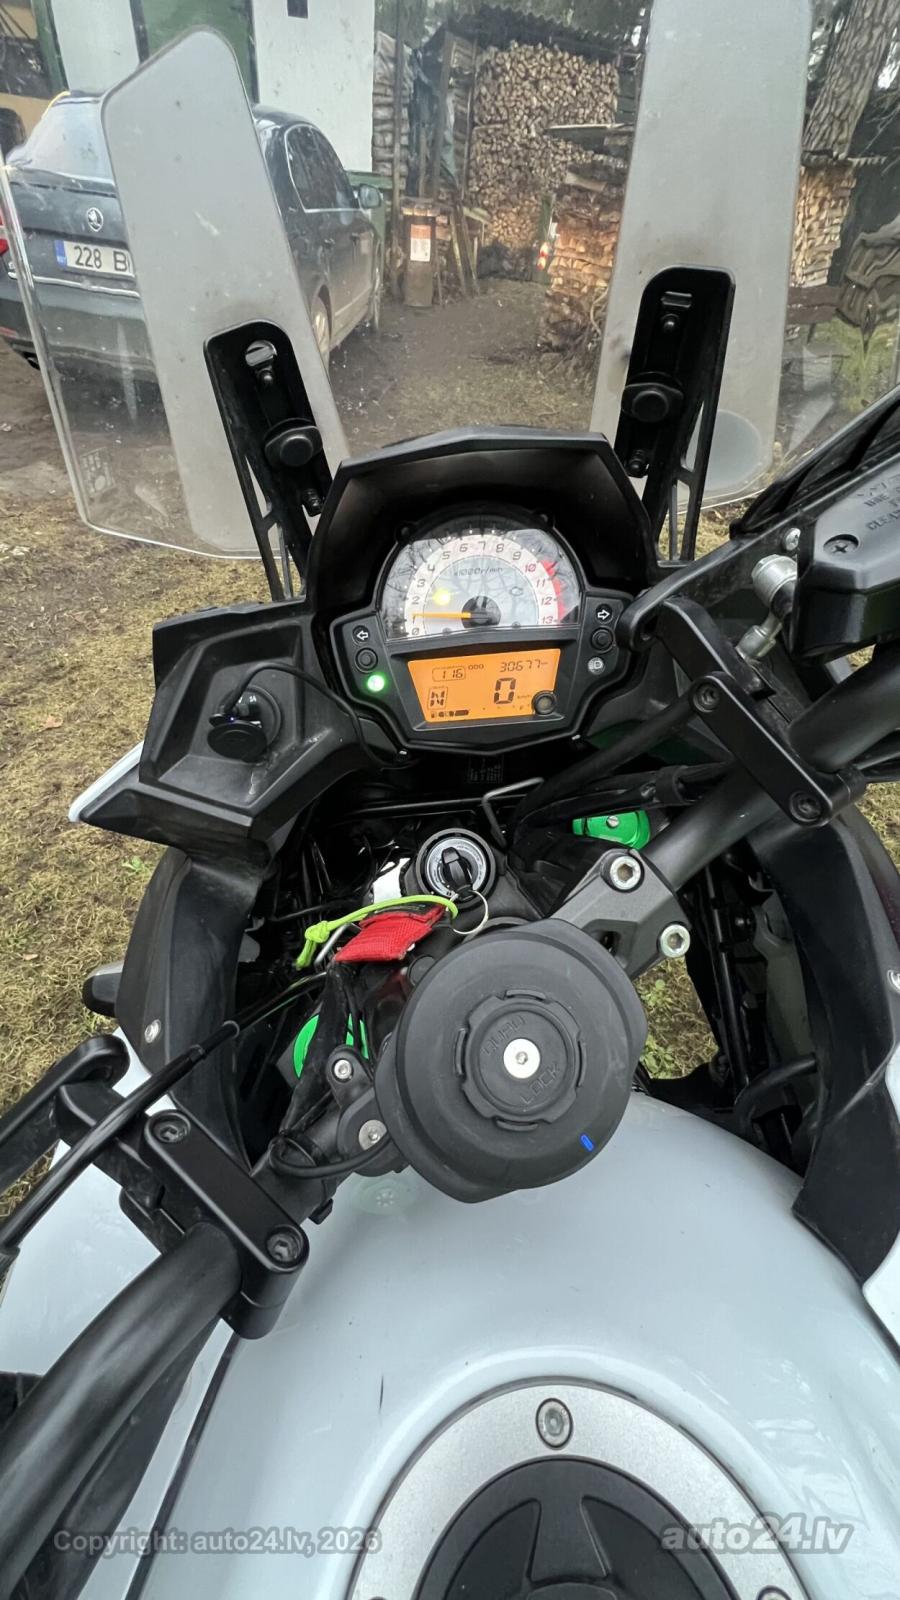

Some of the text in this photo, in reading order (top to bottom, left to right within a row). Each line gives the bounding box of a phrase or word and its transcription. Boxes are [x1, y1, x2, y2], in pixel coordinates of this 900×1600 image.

[74, 245, 131, 272] 228 B
[459, 543, 469, 553] 6
[478, 540, 487, 551] 7
[495, 543, 505, 553] 8
[442, 550, 451, 560] 5
[512, 550, 522, 561] 9
[427, 563, 436, 572] 4
[524, 563, 537, 573] 10
[416, 578, 426, 587] 3
[536, 578, 546, 588] 11
[411, 596, 420, 605] 2
[540, 596, 553, 606] 12
[541, 616, 554, 625] 13
[411, 627, 420, 636] 0
[499, 658, 541, 673] 30677
[493, 677, 517, 705] 0
[430, 690, 446, 707] N
[520, 1060, 560, 1104] LOCK
